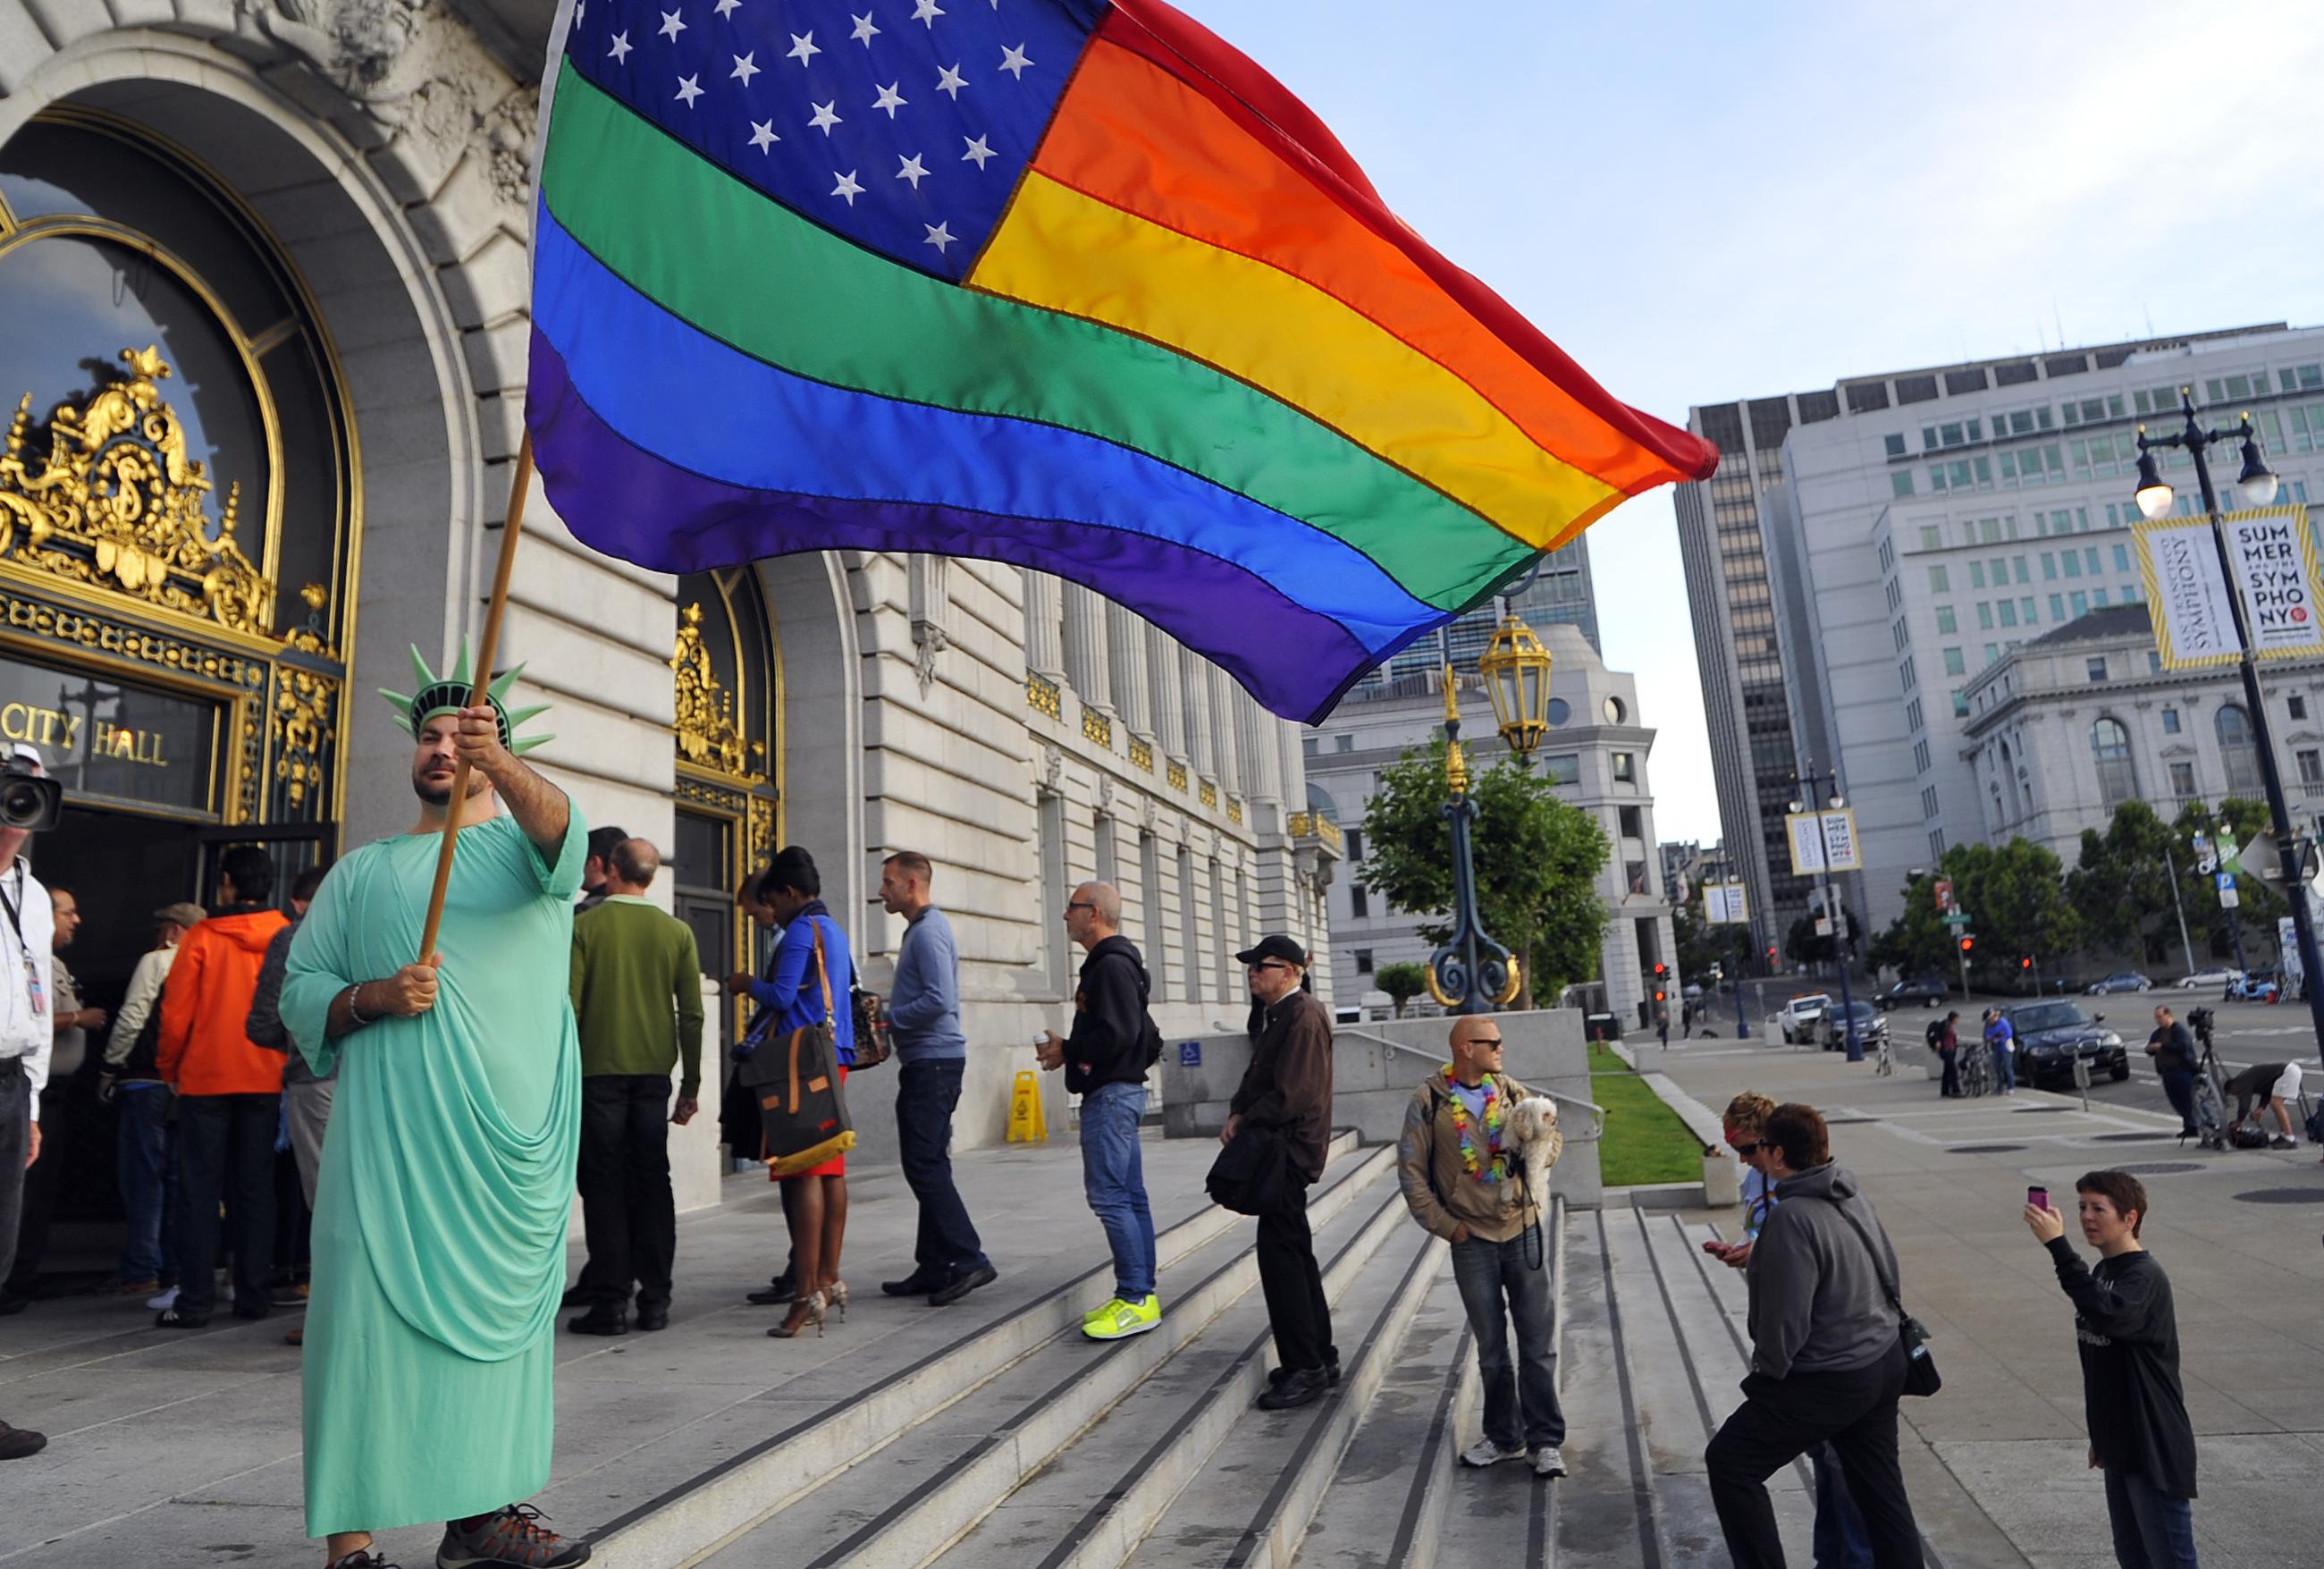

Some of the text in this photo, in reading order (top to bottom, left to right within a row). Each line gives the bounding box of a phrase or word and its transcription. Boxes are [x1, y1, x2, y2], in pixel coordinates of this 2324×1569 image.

[2238, 523, 2289, 544] SUM
[2244, 543, 2294, 561] MER
[2250, 569, 2300, 588] SYM
[2160, 537, 2194, 651] SAN FRANCISCO
[2171, 536, 2210, 649] SYMPHONY
[2254, 588, 2303, 607] PHO
[1, 703, 169, 768] CITY HALL
